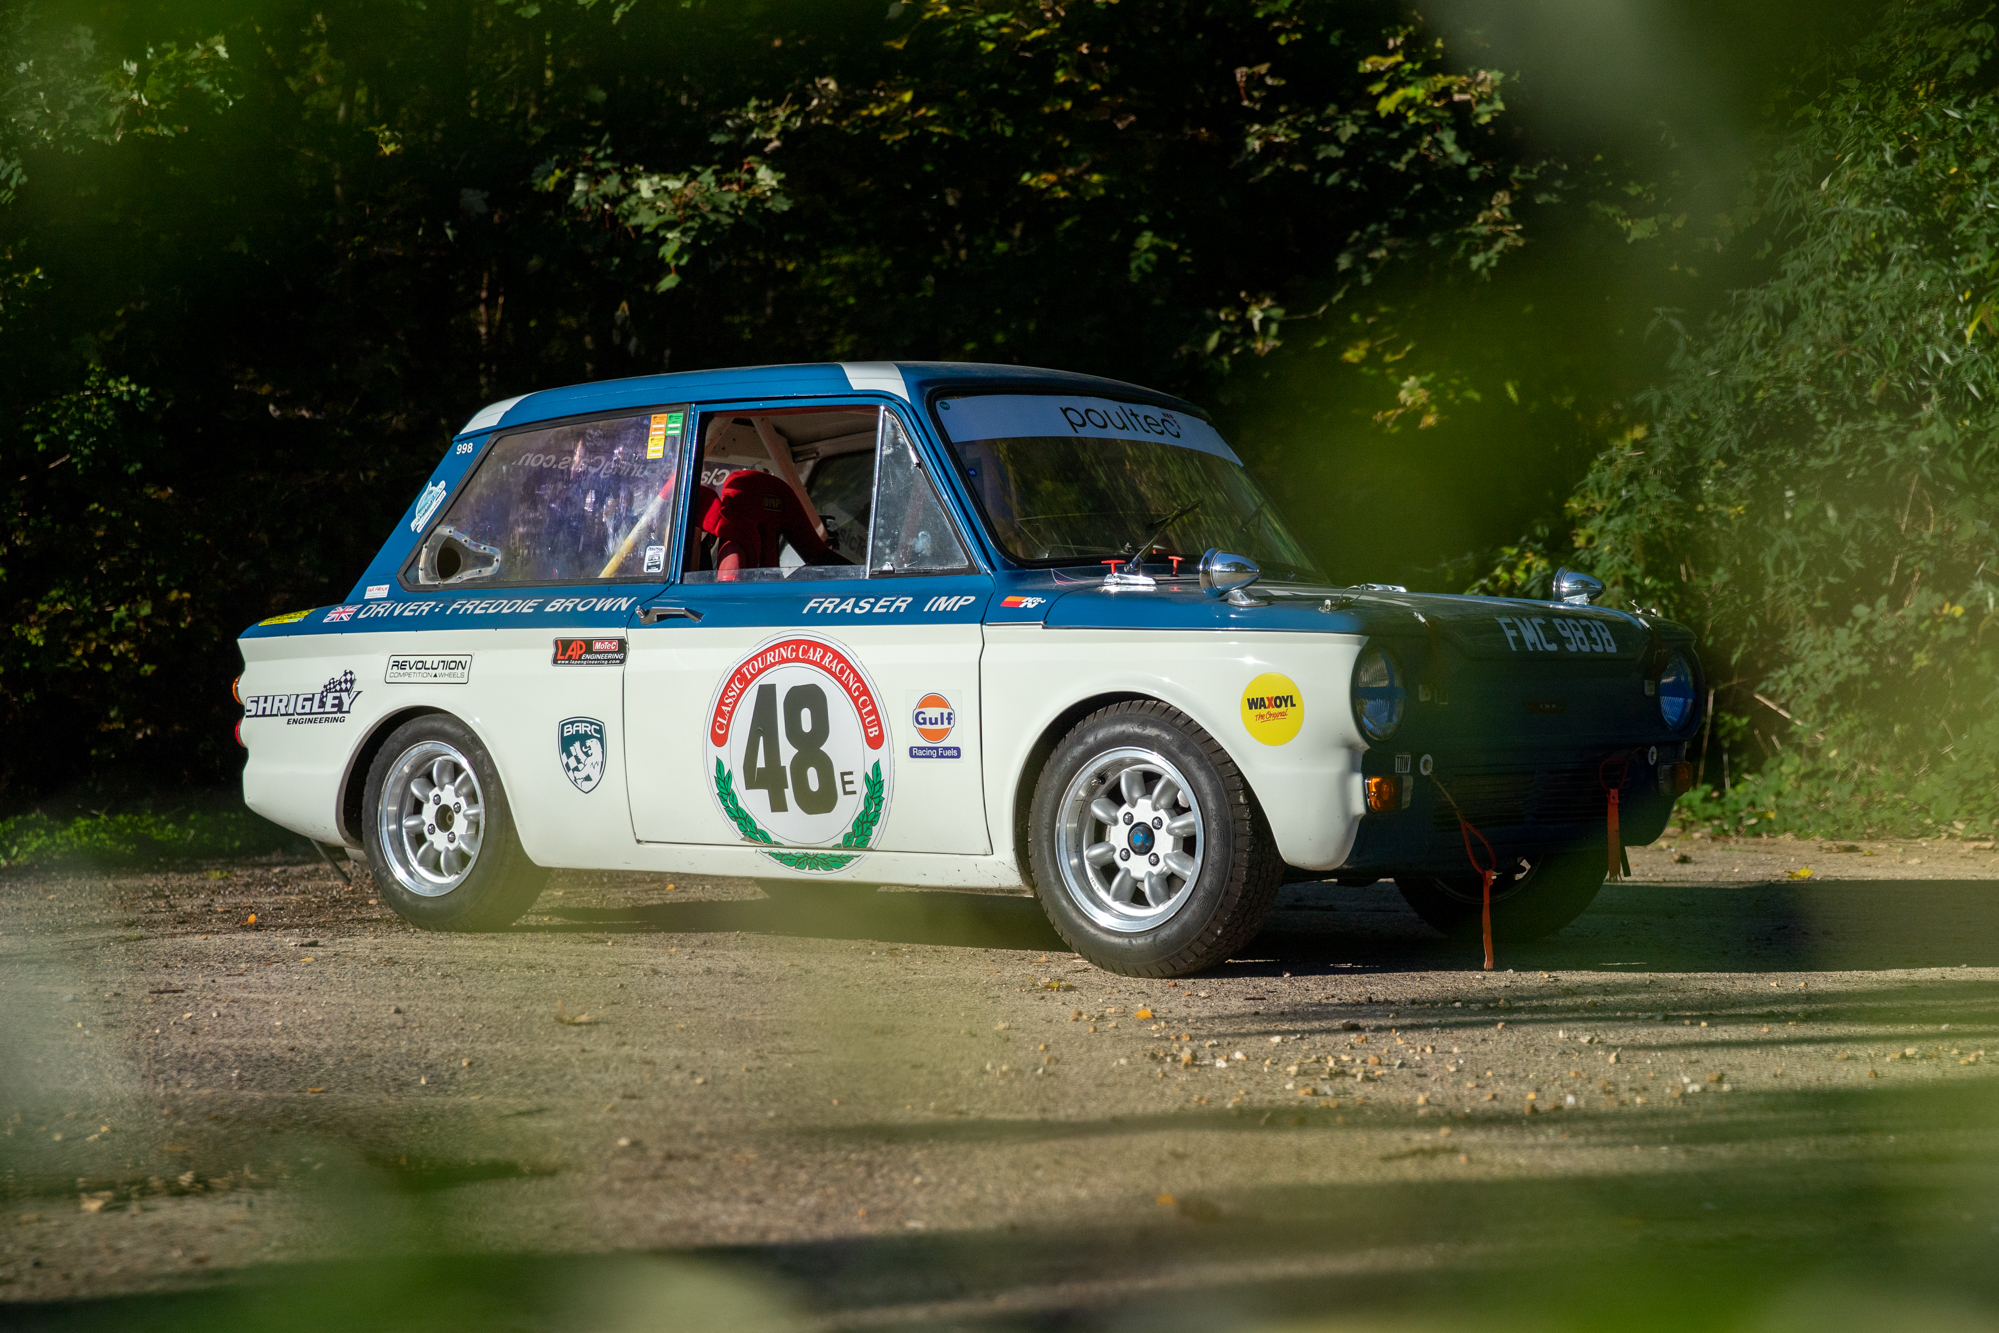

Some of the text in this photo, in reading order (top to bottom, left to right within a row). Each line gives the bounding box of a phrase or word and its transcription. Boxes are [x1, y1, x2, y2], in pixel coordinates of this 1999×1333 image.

[1059, 405, 1180, 439] poultec
[456, 443, 473, 455] 998
[446, 598, 545, 615] FREDDIE
[544, 596, 638, 612] BROWN
[802, 596, 976, 614] FRASER IMP
[1495, 617, 1617, 653] FMC 983B
[557, 640, 586, 660] LAP
[594, 641, 617, 651] MoTeC
[391, 660, 467, 670] REVOLUTION
[715, 644, 880, 738] CLASSIC TOURING CAR RACING CLUB
[245, 691, 363, 718] SHRIGLEY
[1247, 695, 1296, 710] WAXOYL
[286, 716, 346, 725] ENGINEERING
[914, 711, 953, 725] Gulf
[563, 722, 601, 738] BARC
[743, 683, 857, 815] 48 E
[912, 748, 958, 758] Racing Fuels
